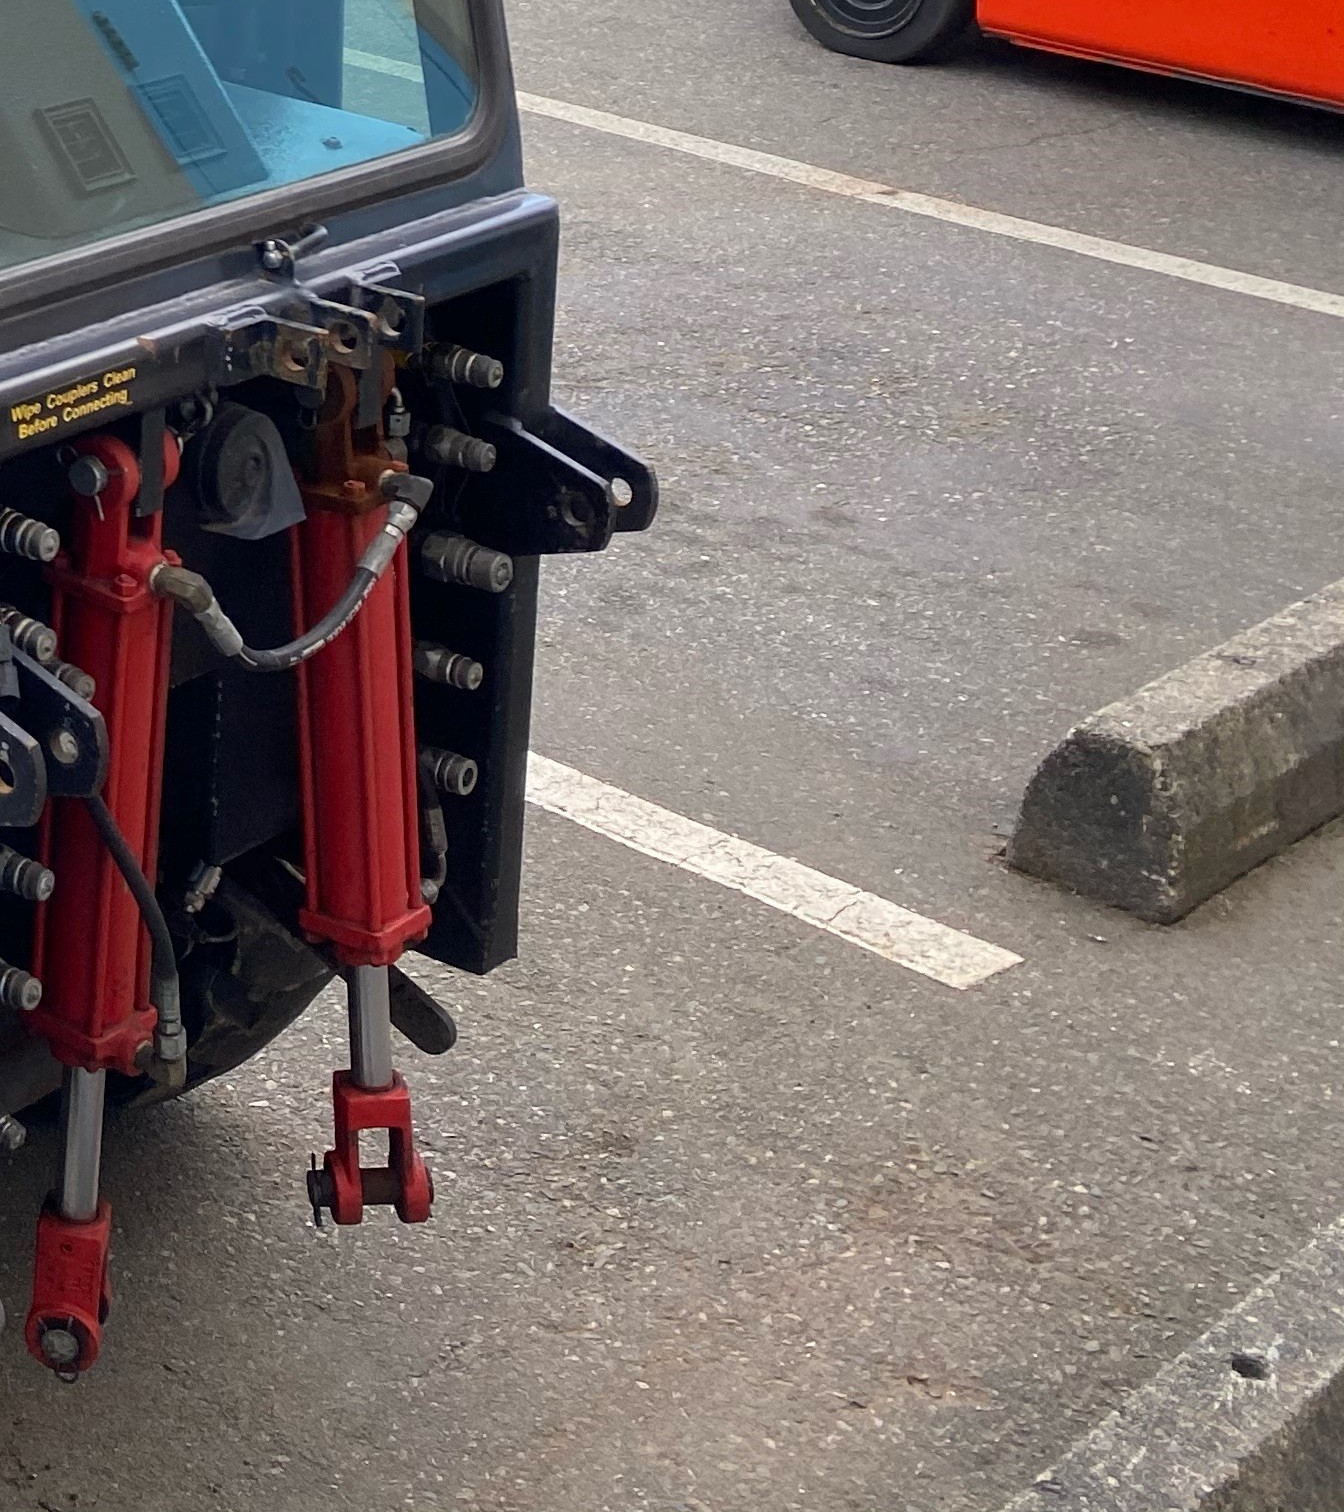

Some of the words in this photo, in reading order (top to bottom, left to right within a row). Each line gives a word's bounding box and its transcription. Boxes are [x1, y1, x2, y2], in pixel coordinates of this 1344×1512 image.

[11, 402, 42, 422] Wipe
[47, 381, 98, 408] Couplers
[103, 367, 136, 388] Clean
[18, 415, 58, 440] Before
[62, 389, 128, 422] Connecting
